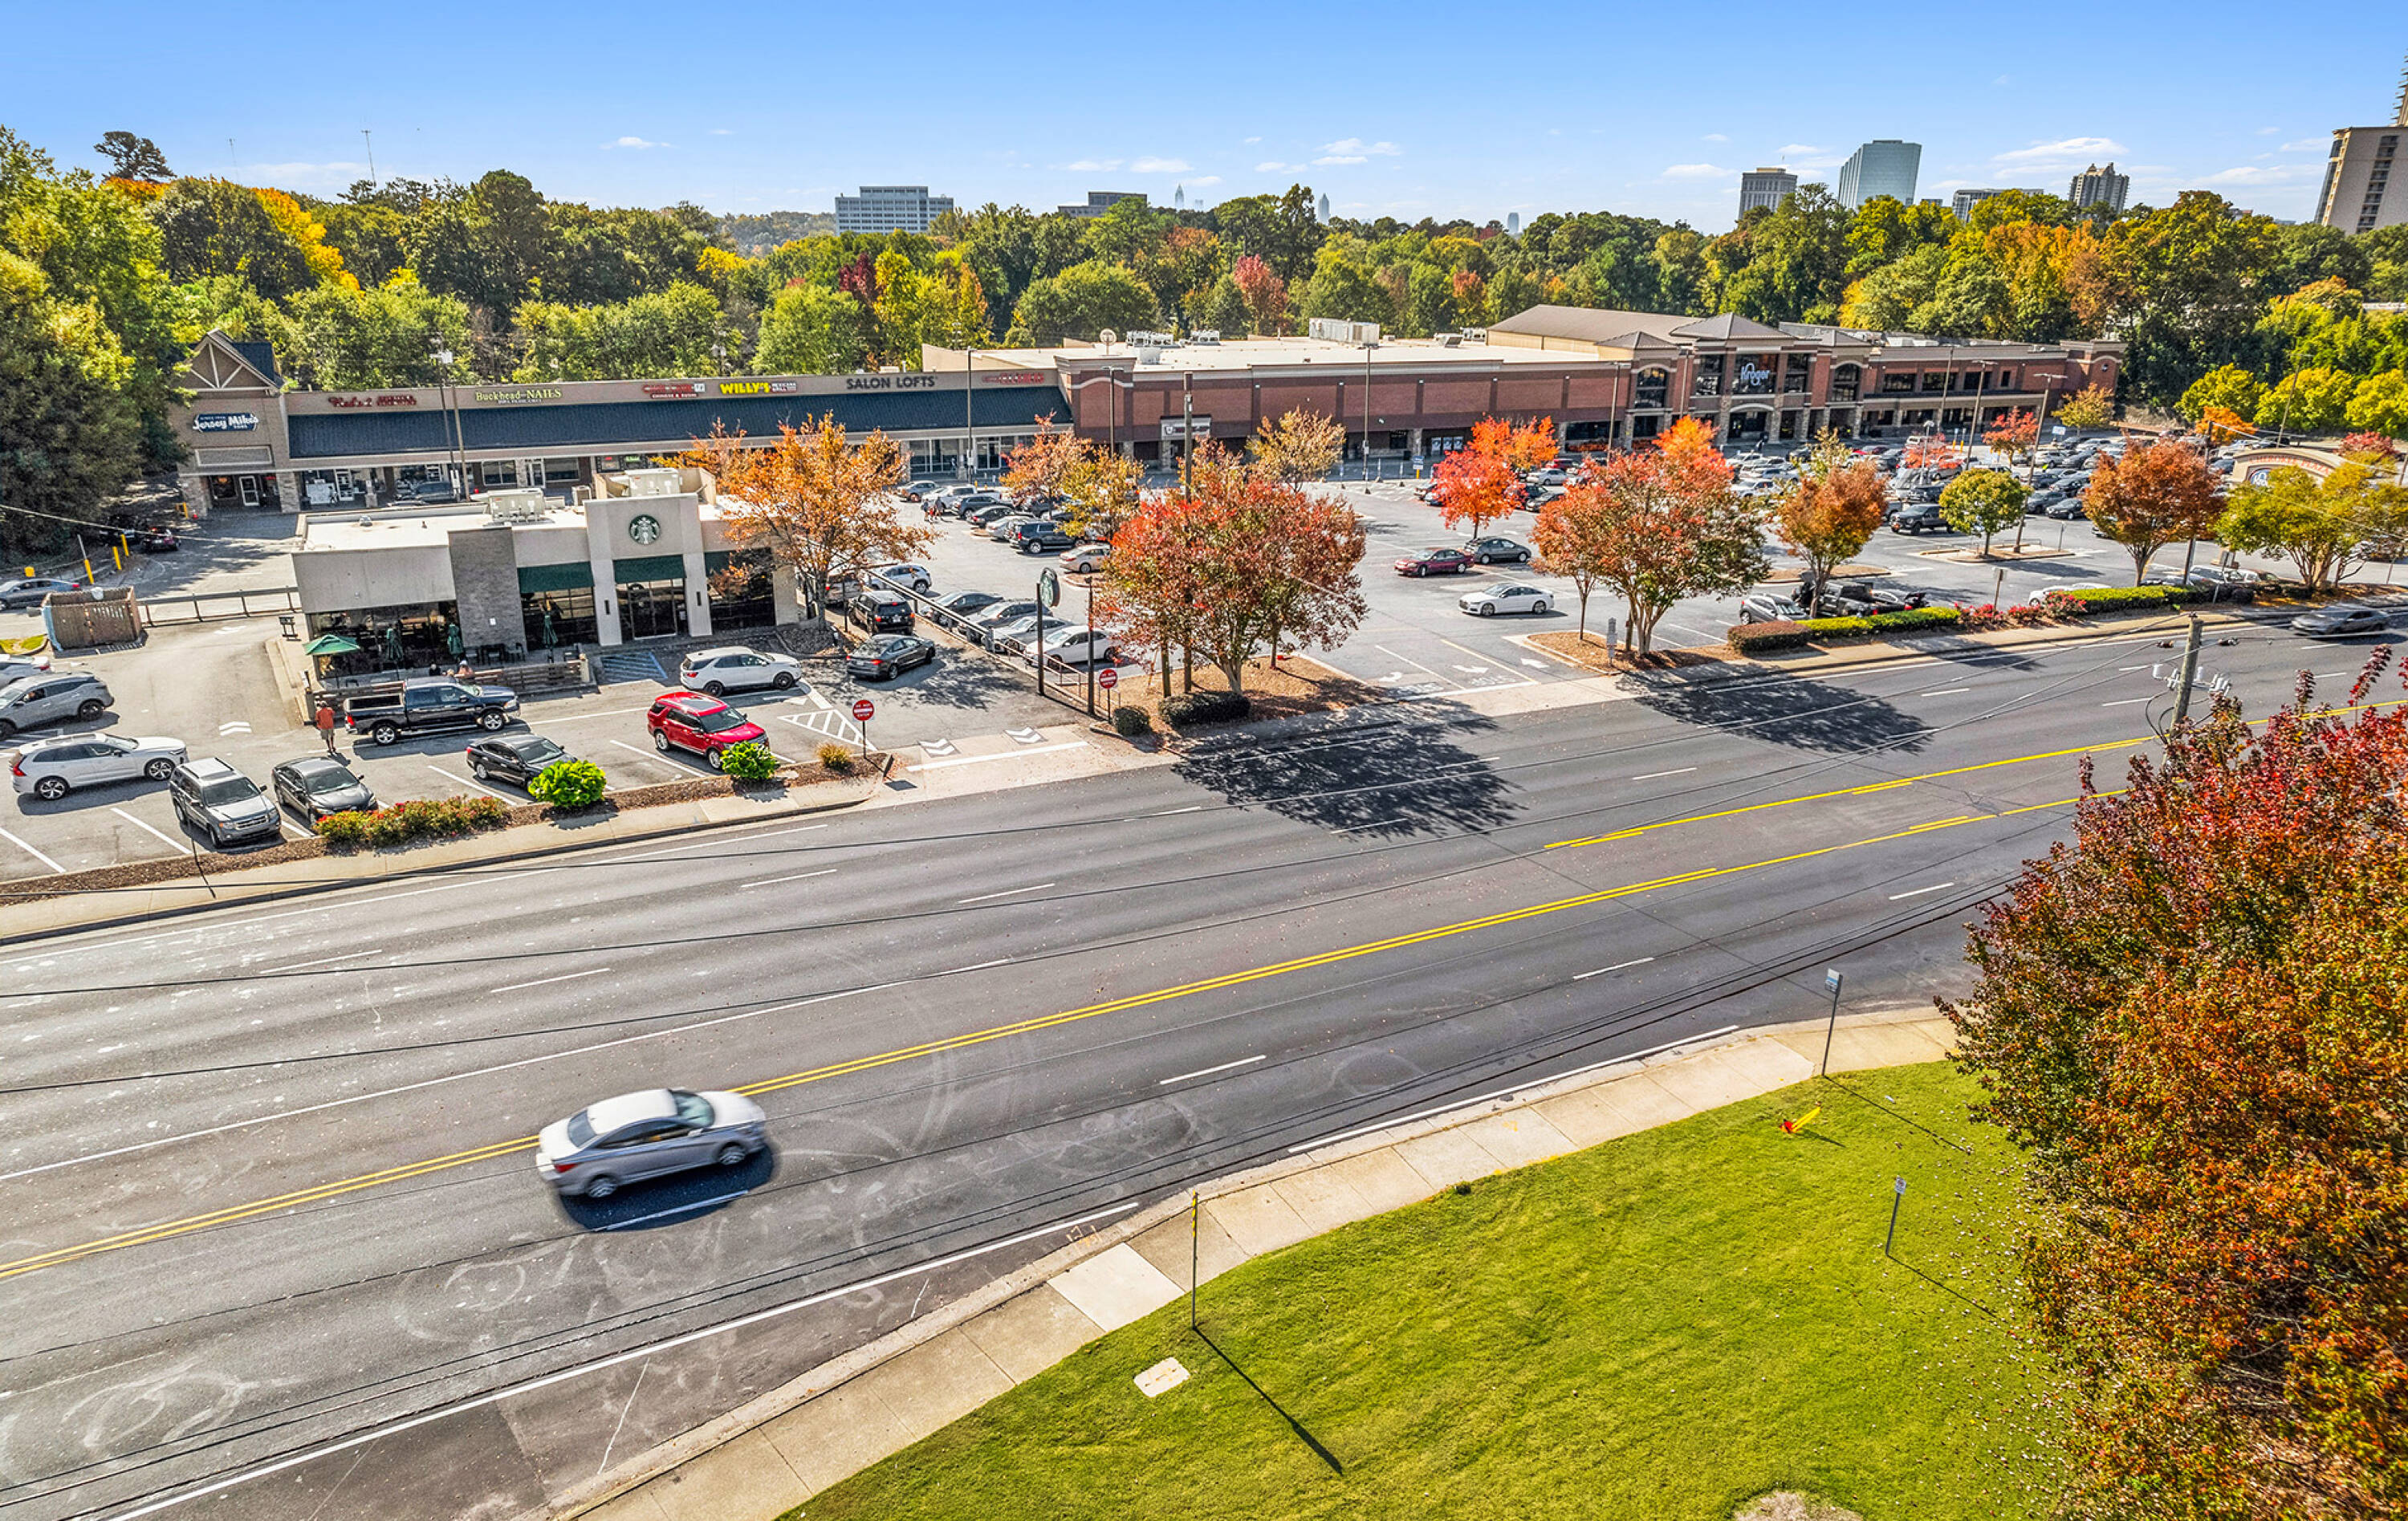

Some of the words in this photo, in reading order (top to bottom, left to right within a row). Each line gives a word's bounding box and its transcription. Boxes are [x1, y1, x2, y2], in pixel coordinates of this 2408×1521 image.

[1741, 363, 1770, 385] Kroger
[719, 382, 771, 394] WILLY'S
[846, 377, 891, 390] SALON
[896, 376, 935, 388] LOFTS
[475, 391, 521, 401] Buckhead
[527, 388, 562, 399] NAILS
[193, 419, 227, 430] Jersey
[2300, 460, 2331, 475] PLAZA
